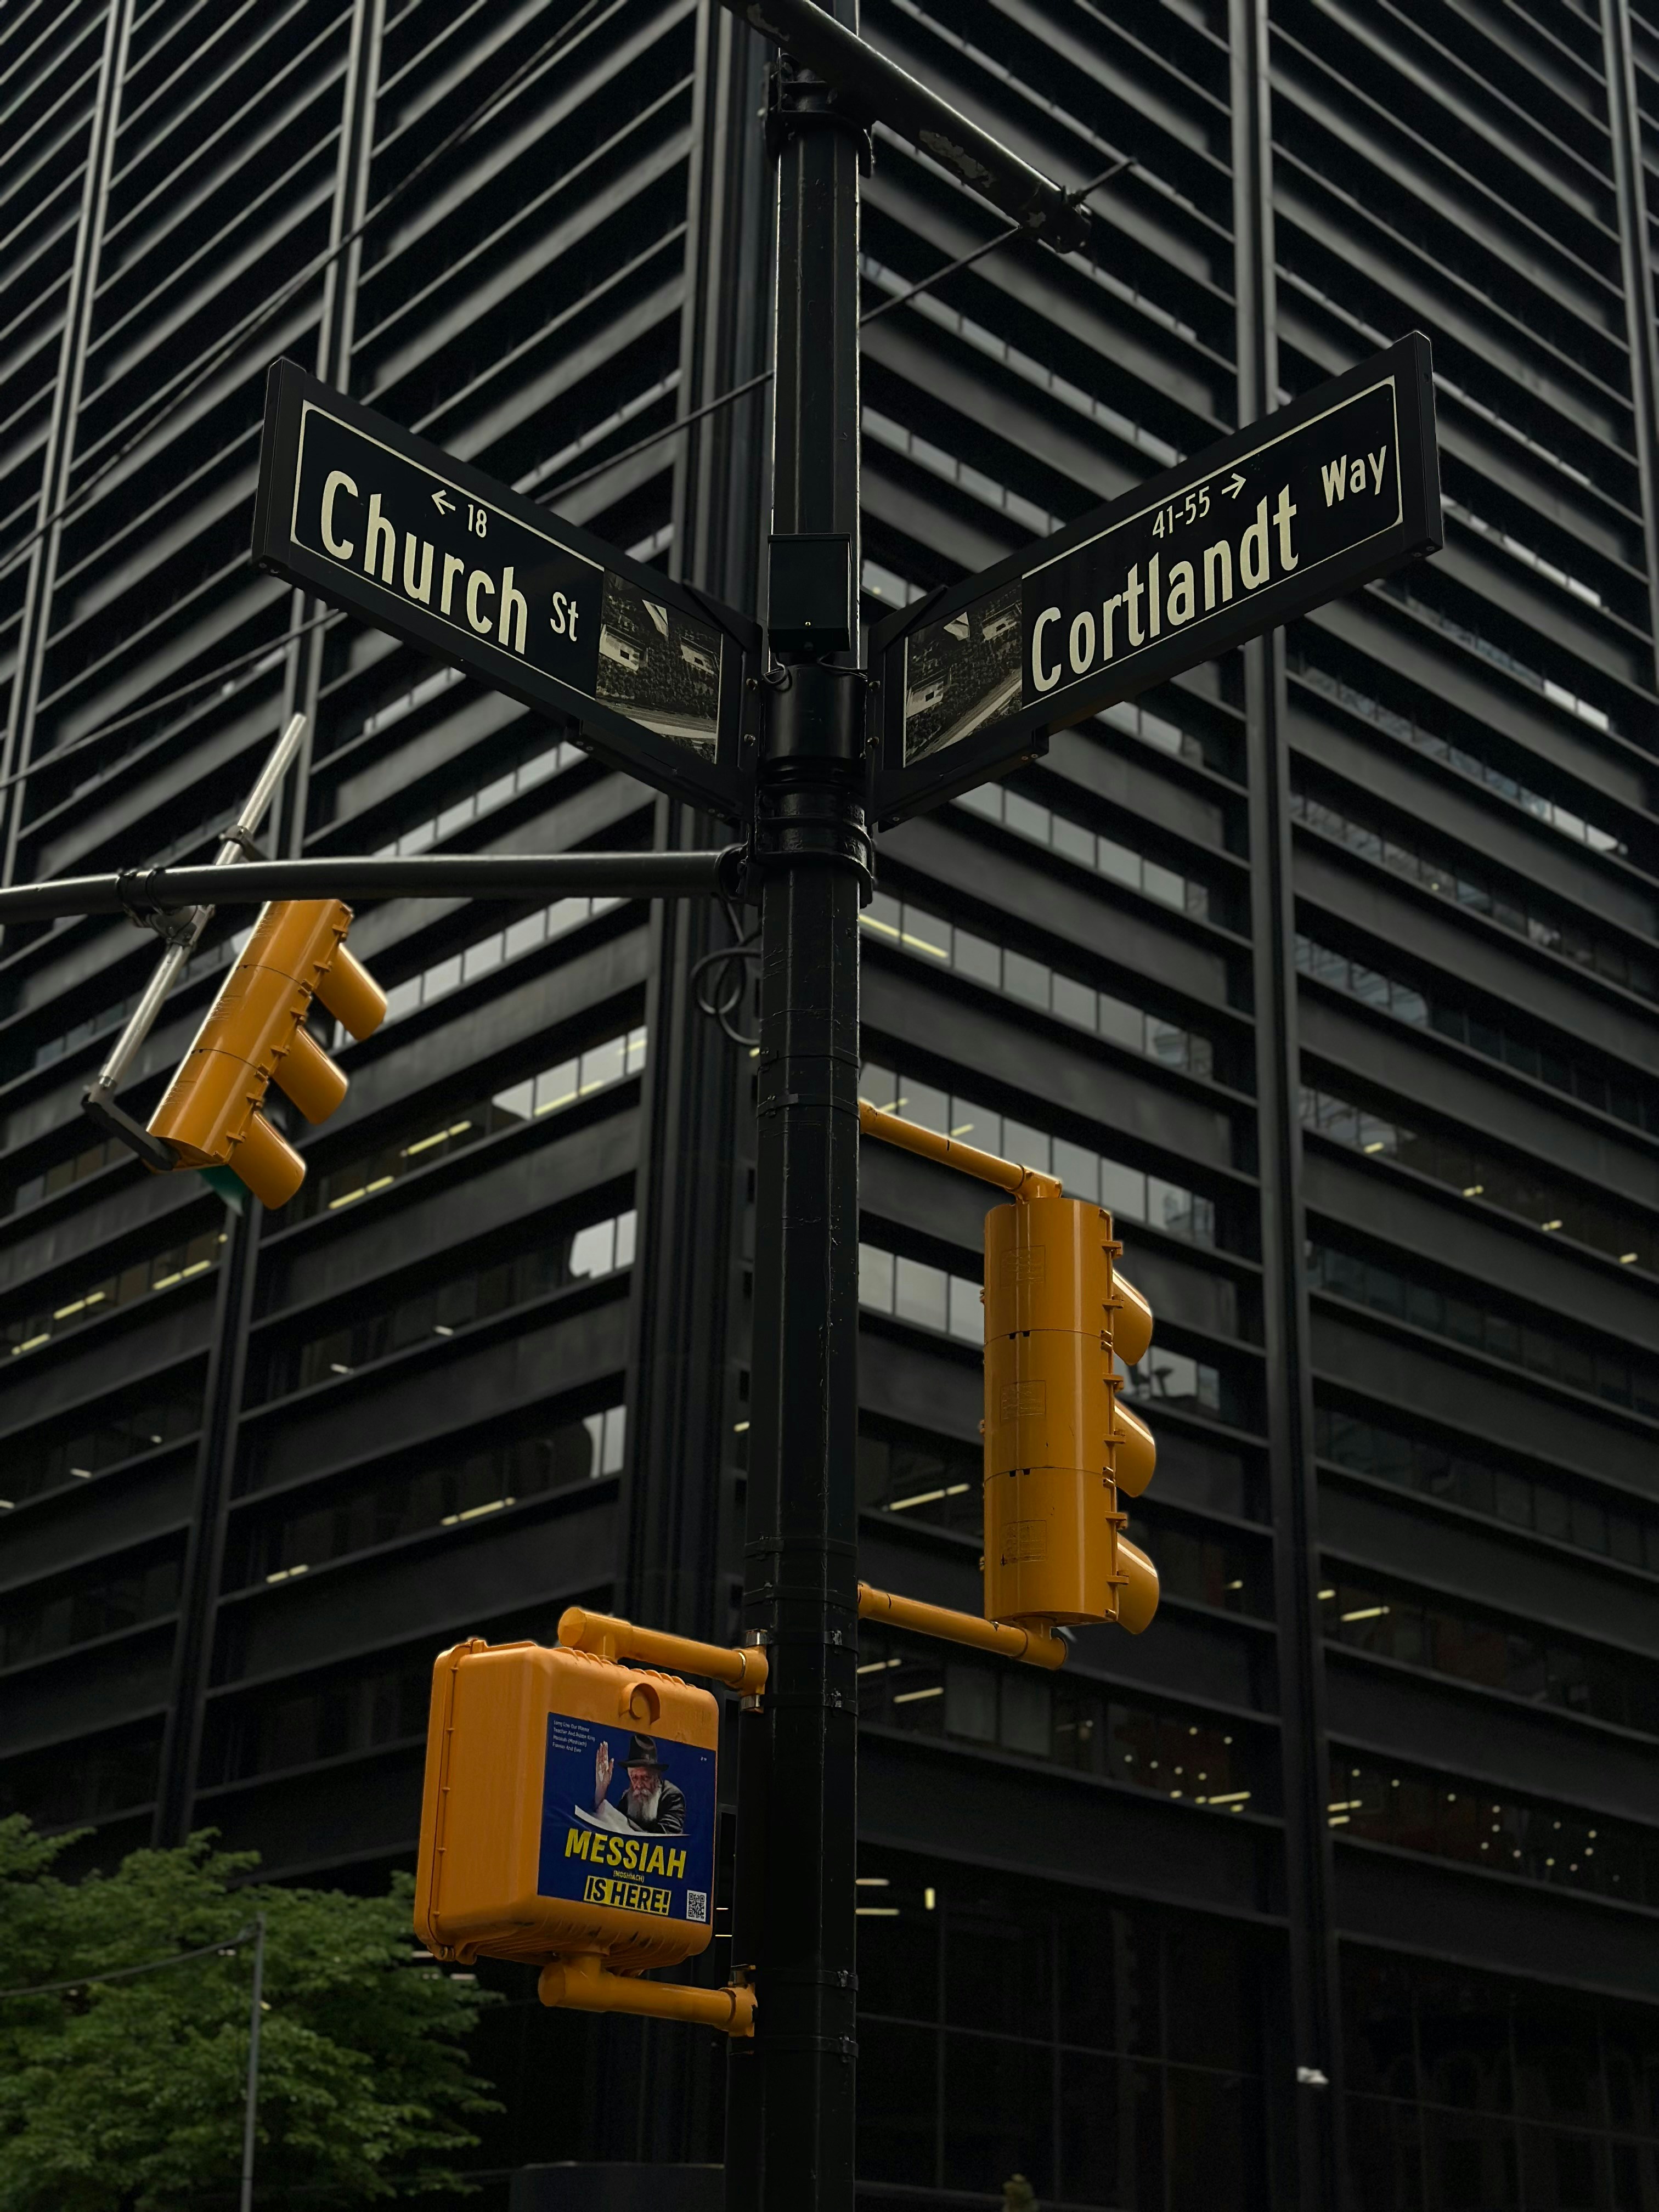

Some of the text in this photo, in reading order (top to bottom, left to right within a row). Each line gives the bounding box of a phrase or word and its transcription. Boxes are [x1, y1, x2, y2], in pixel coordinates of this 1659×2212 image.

[467, 504, 487, 538] 18
[1152, 486, 1210, 539] 41-55
[321, 470, 579, 655] Church St
[1032, 445, 1387, 692] Cortlandt Way
[565, 1827, 687, 1879] MESSIAH
[613, 1870, 645, 1883] (MOSHIACH)
[586, 1877, 670, 1914] IS HERE!
